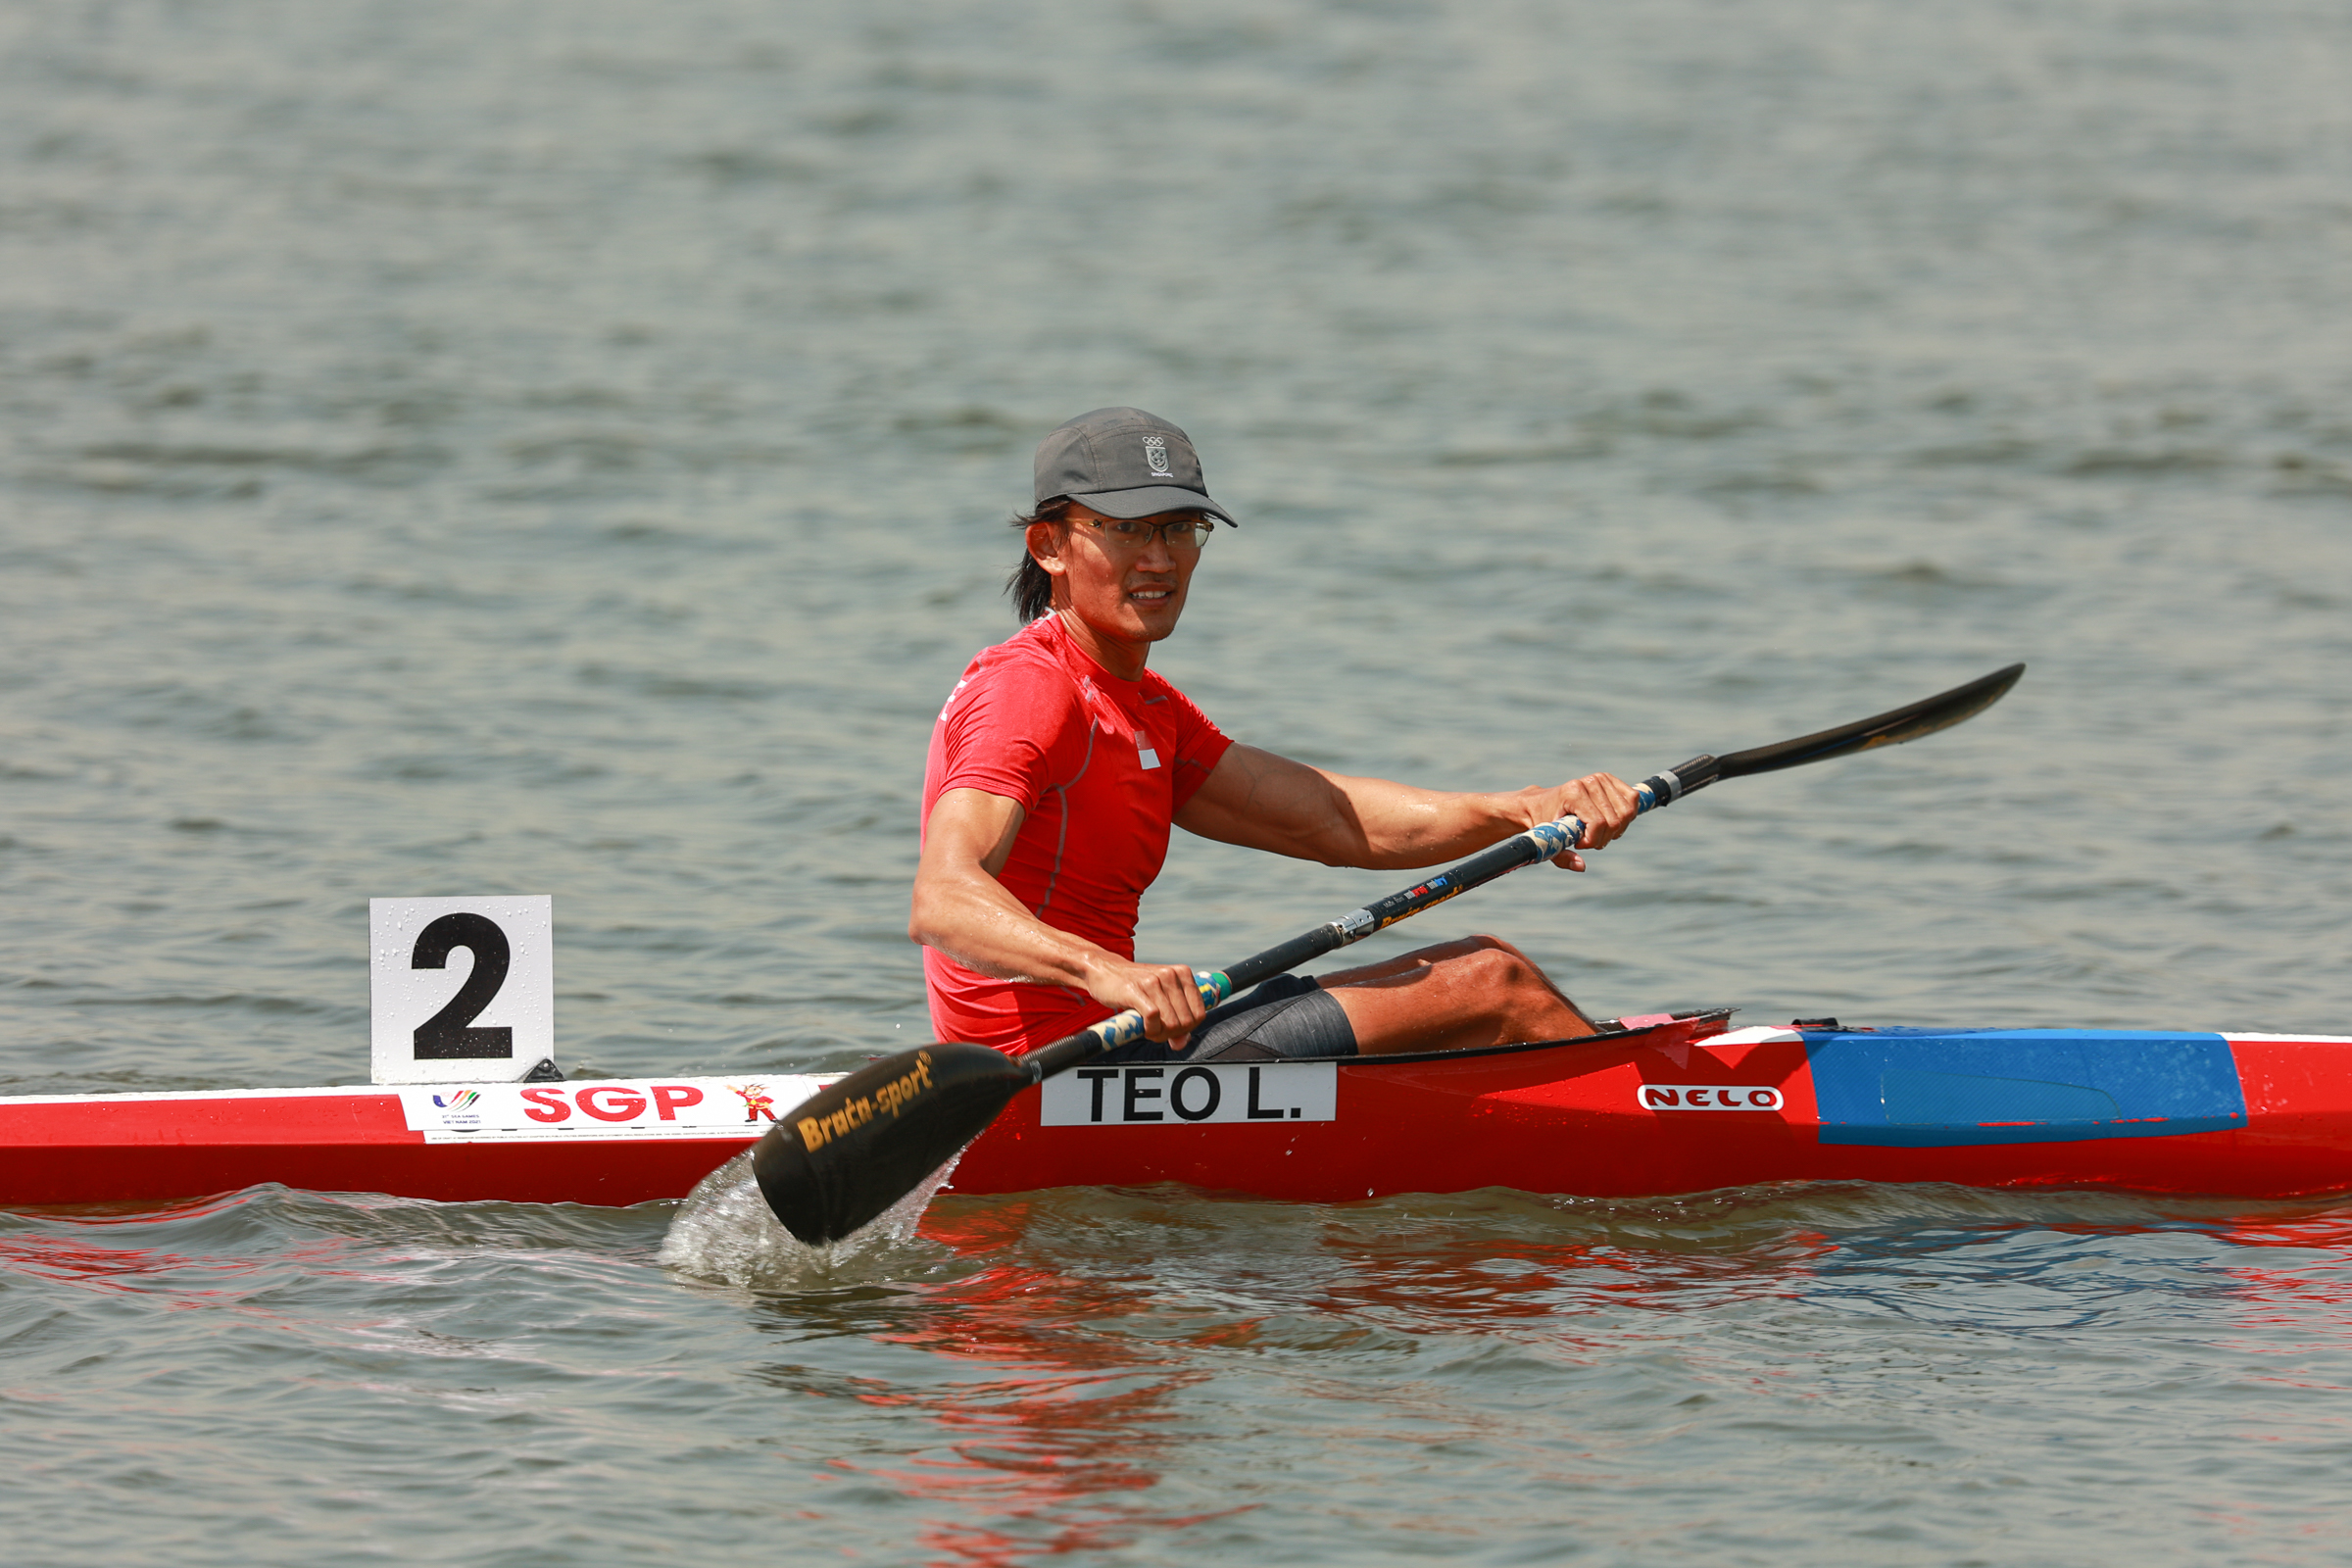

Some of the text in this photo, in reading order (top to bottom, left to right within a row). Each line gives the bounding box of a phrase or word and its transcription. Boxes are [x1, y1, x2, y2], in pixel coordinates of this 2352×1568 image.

[412, 912, 513, 1059] 2
[520, 1086, 704, 1123] SGP
[1077, 1066, 1301, 1122] TEO L.
[1645, 1089, 1777, 1106] NELO
